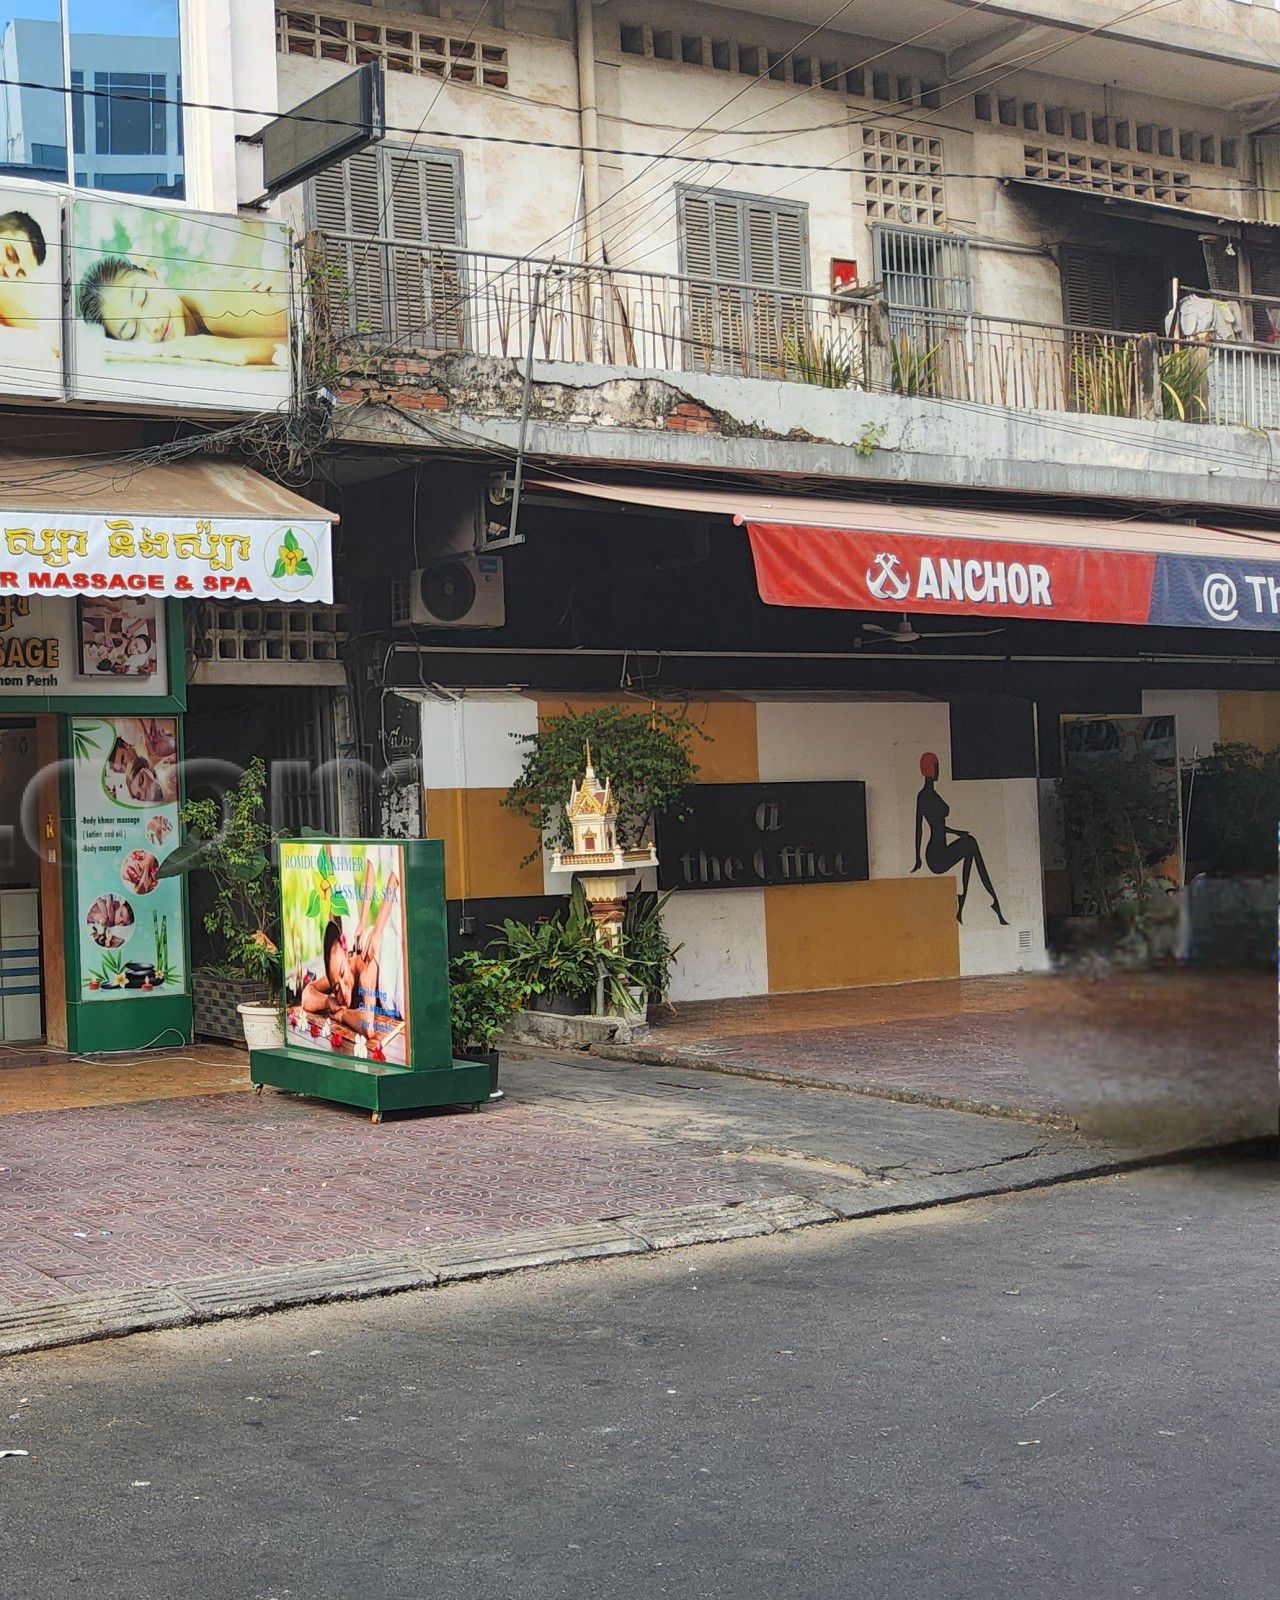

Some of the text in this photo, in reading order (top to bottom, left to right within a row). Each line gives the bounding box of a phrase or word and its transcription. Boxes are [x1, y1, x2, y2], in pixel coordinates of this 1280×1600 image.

[28, 572, 165, 591] MASSAGE
[174, 575, 194, 592] &
[203, 575, 253, 593] SPA
[917, 556, 1053, 606] ANCHOR
[1202, 573, 1280, 622] @ Th
[26, 675, 58, 687] Penh
[116, 816, 140, 825] massage
[98, 845, 122, 853] massage
[331, 856, 365, 872] KHMER
[680, 850, 744, 883] the
